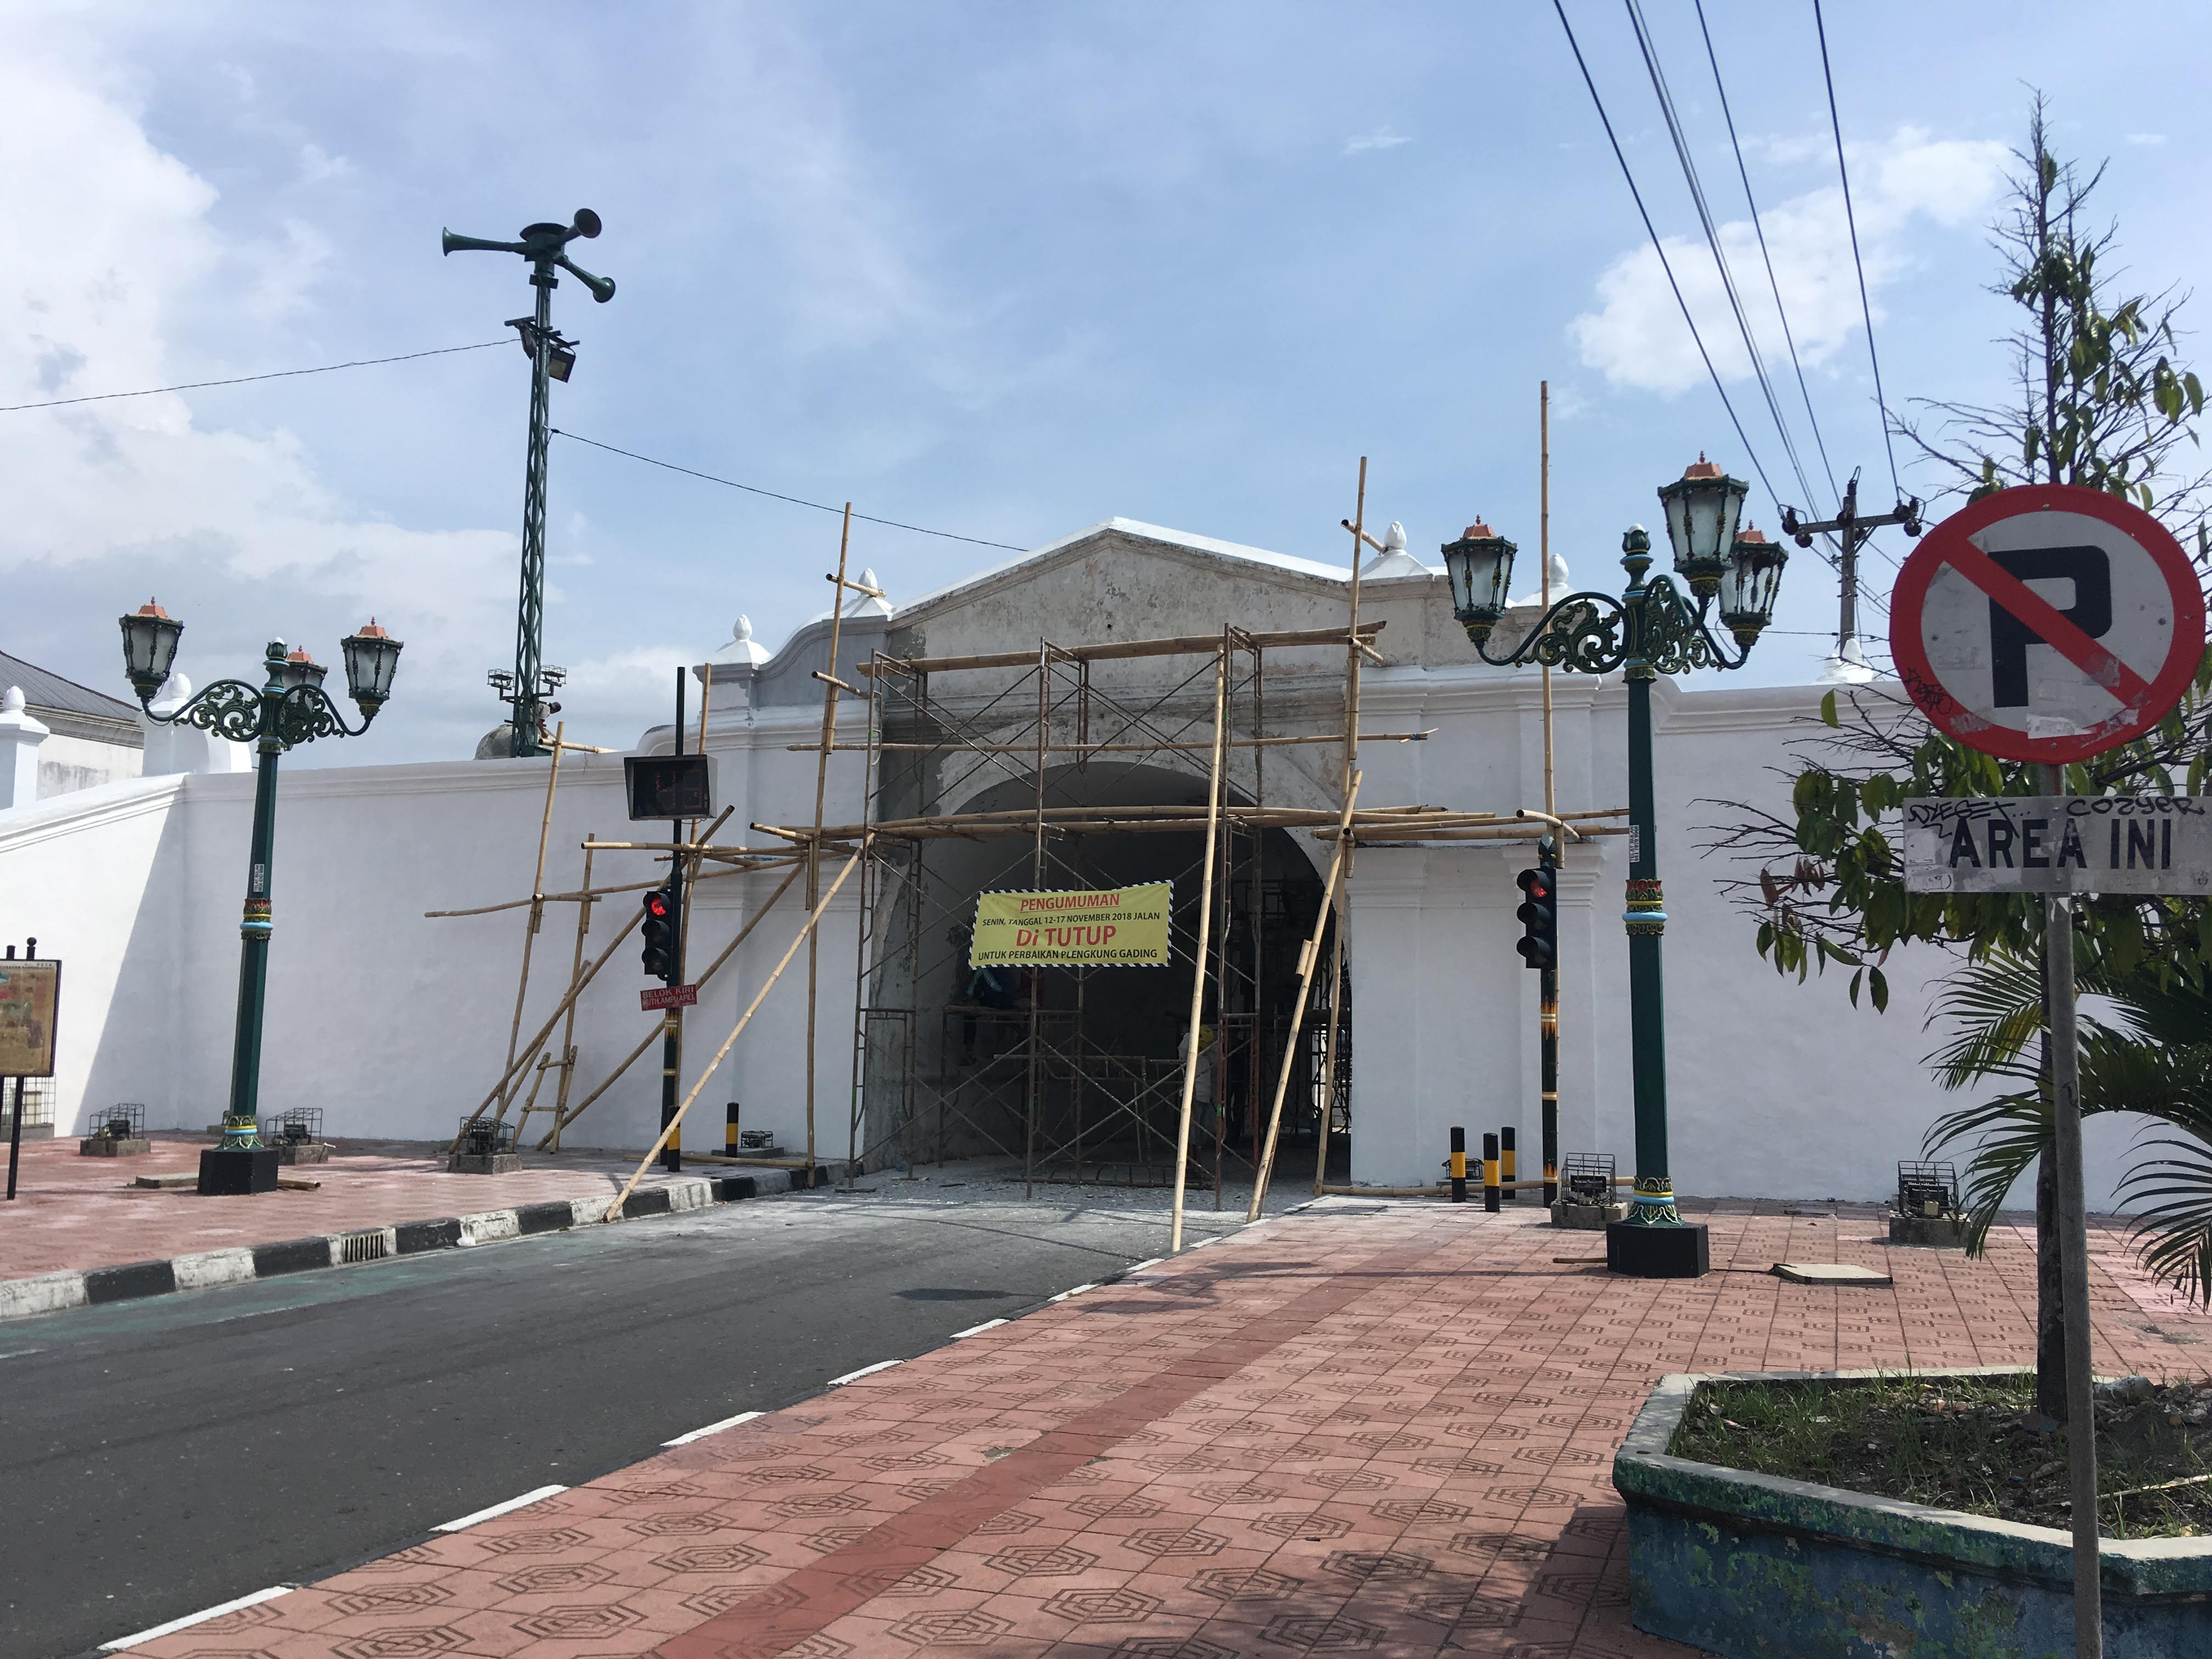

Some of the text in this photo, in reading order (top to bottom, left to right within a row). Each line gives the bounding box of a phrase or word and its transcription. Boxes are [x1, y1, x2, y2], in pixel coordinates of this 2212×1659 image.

[1949, 818, 2171, 870] AREA INI
[1020, 894, 1120, 911] PENGUMUMAN
[1008, 917, 1042, 926] TANGGAL
[1045, 916, 1065, 924] 12-17
[1066, 913, 1110, 922] NOVEMBER
[1133, 912, 1160, 921] JALAN
[1016, 925, 1116, 947] Di TUTUP
[978, 949, 1158, 960] UNTUK PERBAIKAN PLENGKUNG GADING
[642, 986, 694, 998] BELOK KIRI
